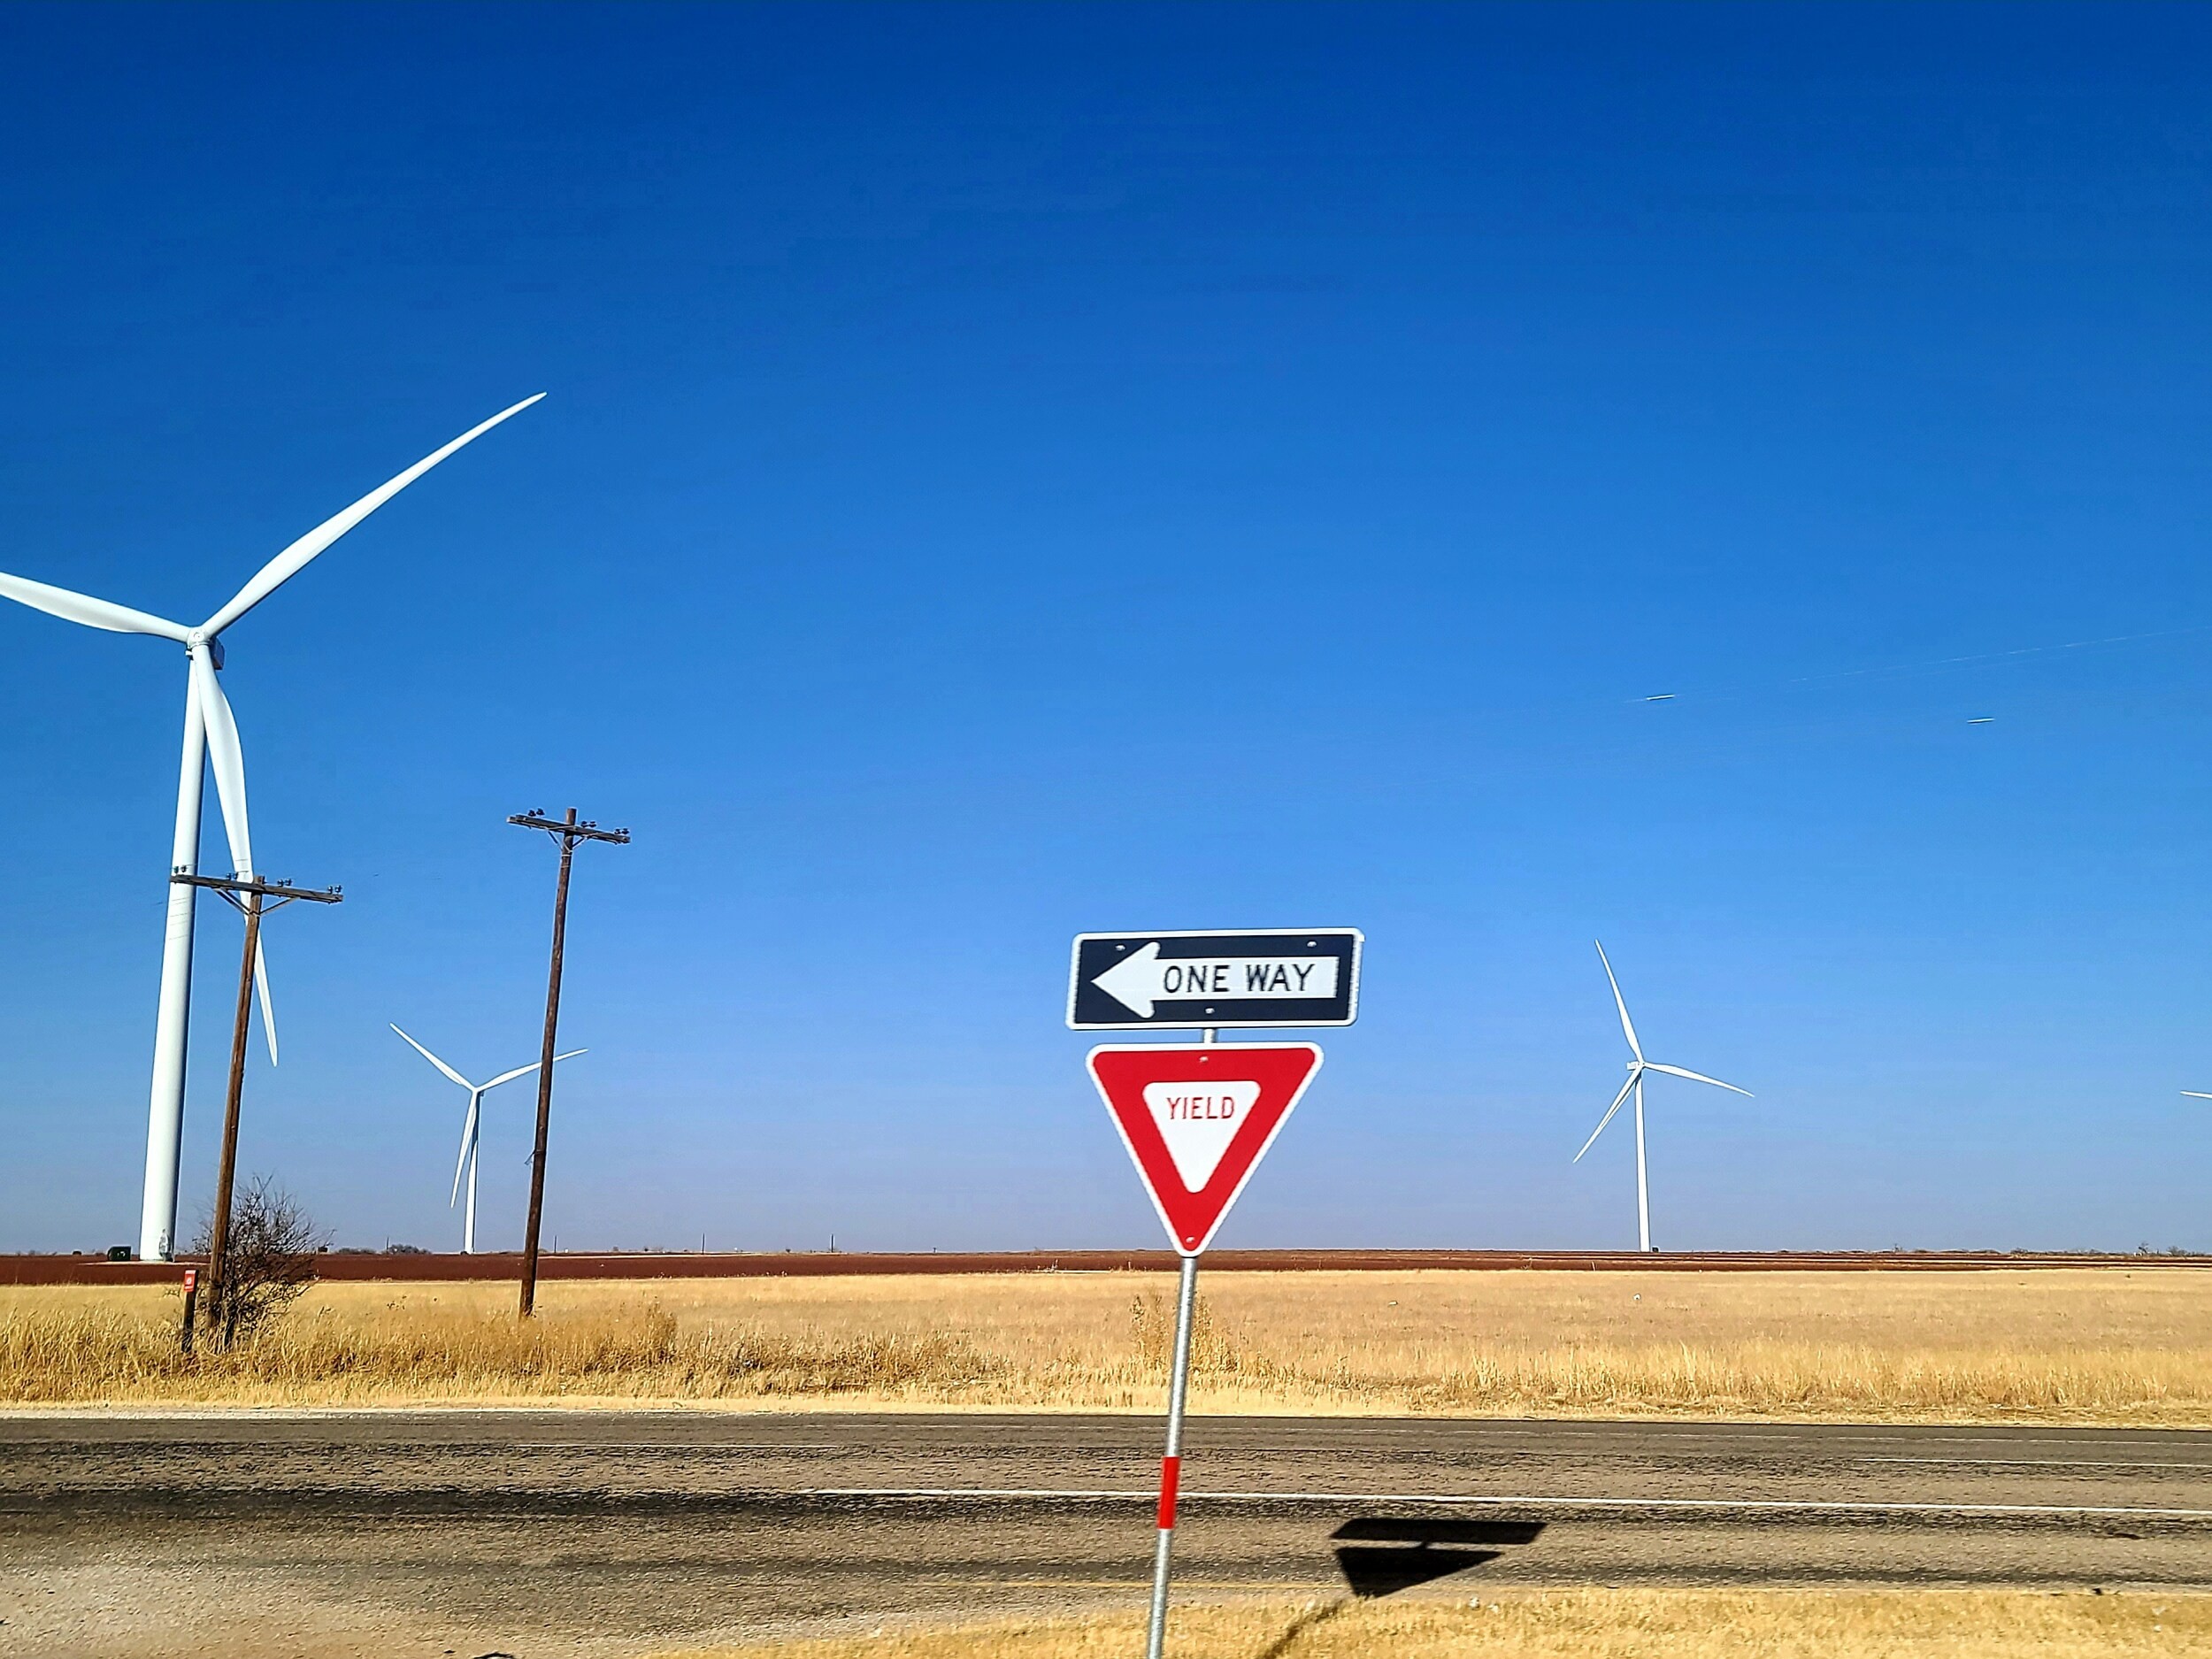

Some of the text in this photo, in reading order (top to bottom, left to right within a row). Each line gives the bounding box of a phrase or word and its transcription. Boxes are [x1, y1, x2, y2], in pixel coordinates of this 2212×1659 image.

[1164, 964, 1316, 993] ONE WAY
[1166, 1096, 1235, 1119] YIELD
